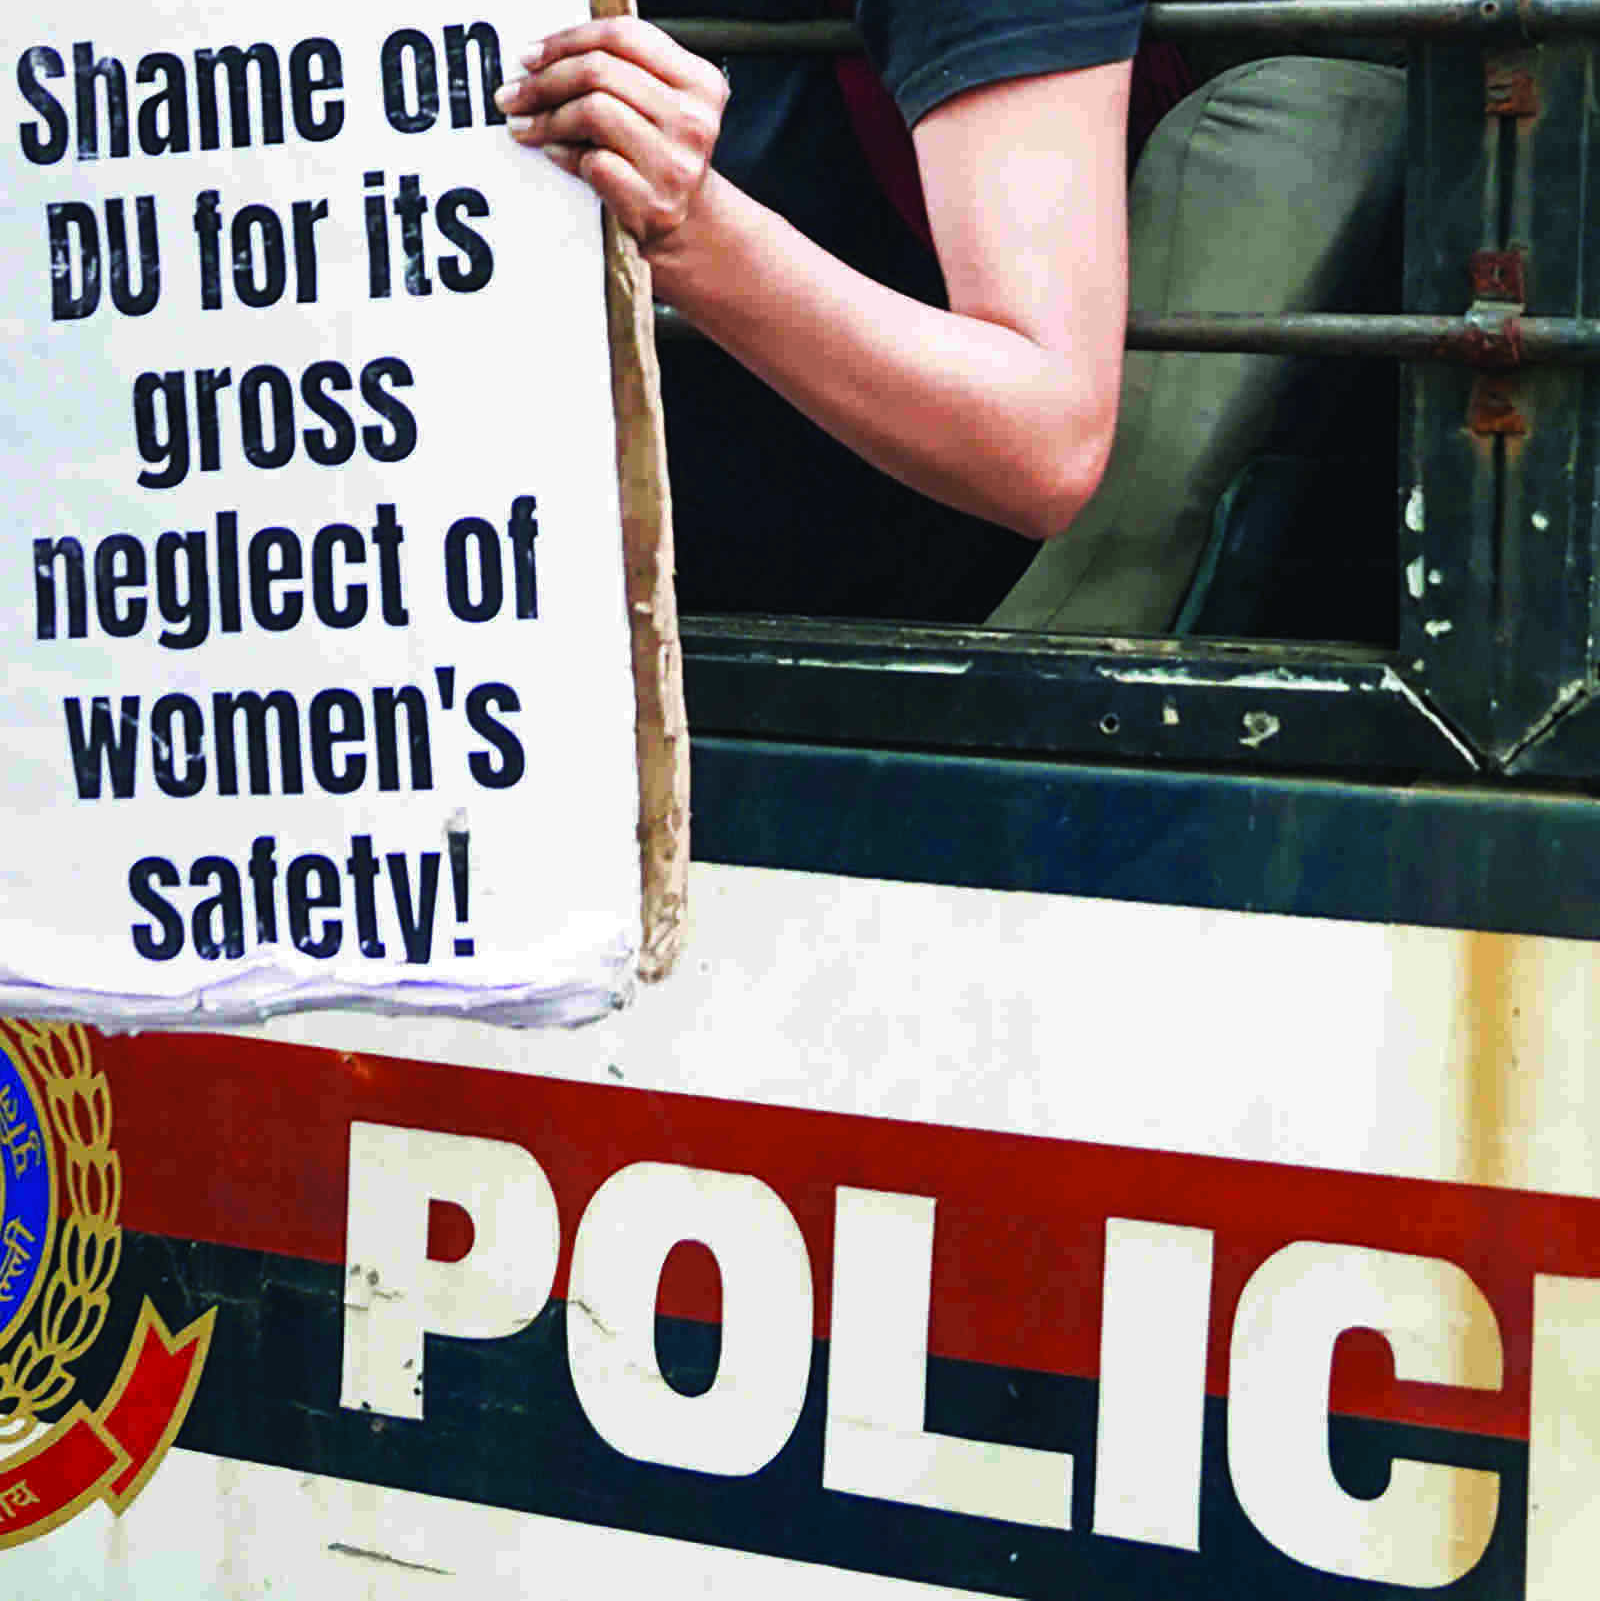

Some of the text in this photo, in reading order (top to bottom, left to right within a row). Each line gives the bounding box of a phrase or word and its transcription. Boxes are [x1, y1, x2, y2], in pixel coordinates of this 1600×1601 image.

[17, 20, 507, 167] Shame on
[47, 170, 495, 323] DU for its
[132, 355, 418, 490] gross
[33, 494, 539, 651] neglect of
[64, 665, 527, 801] women's
[128, 829, 475, 965] safety!
